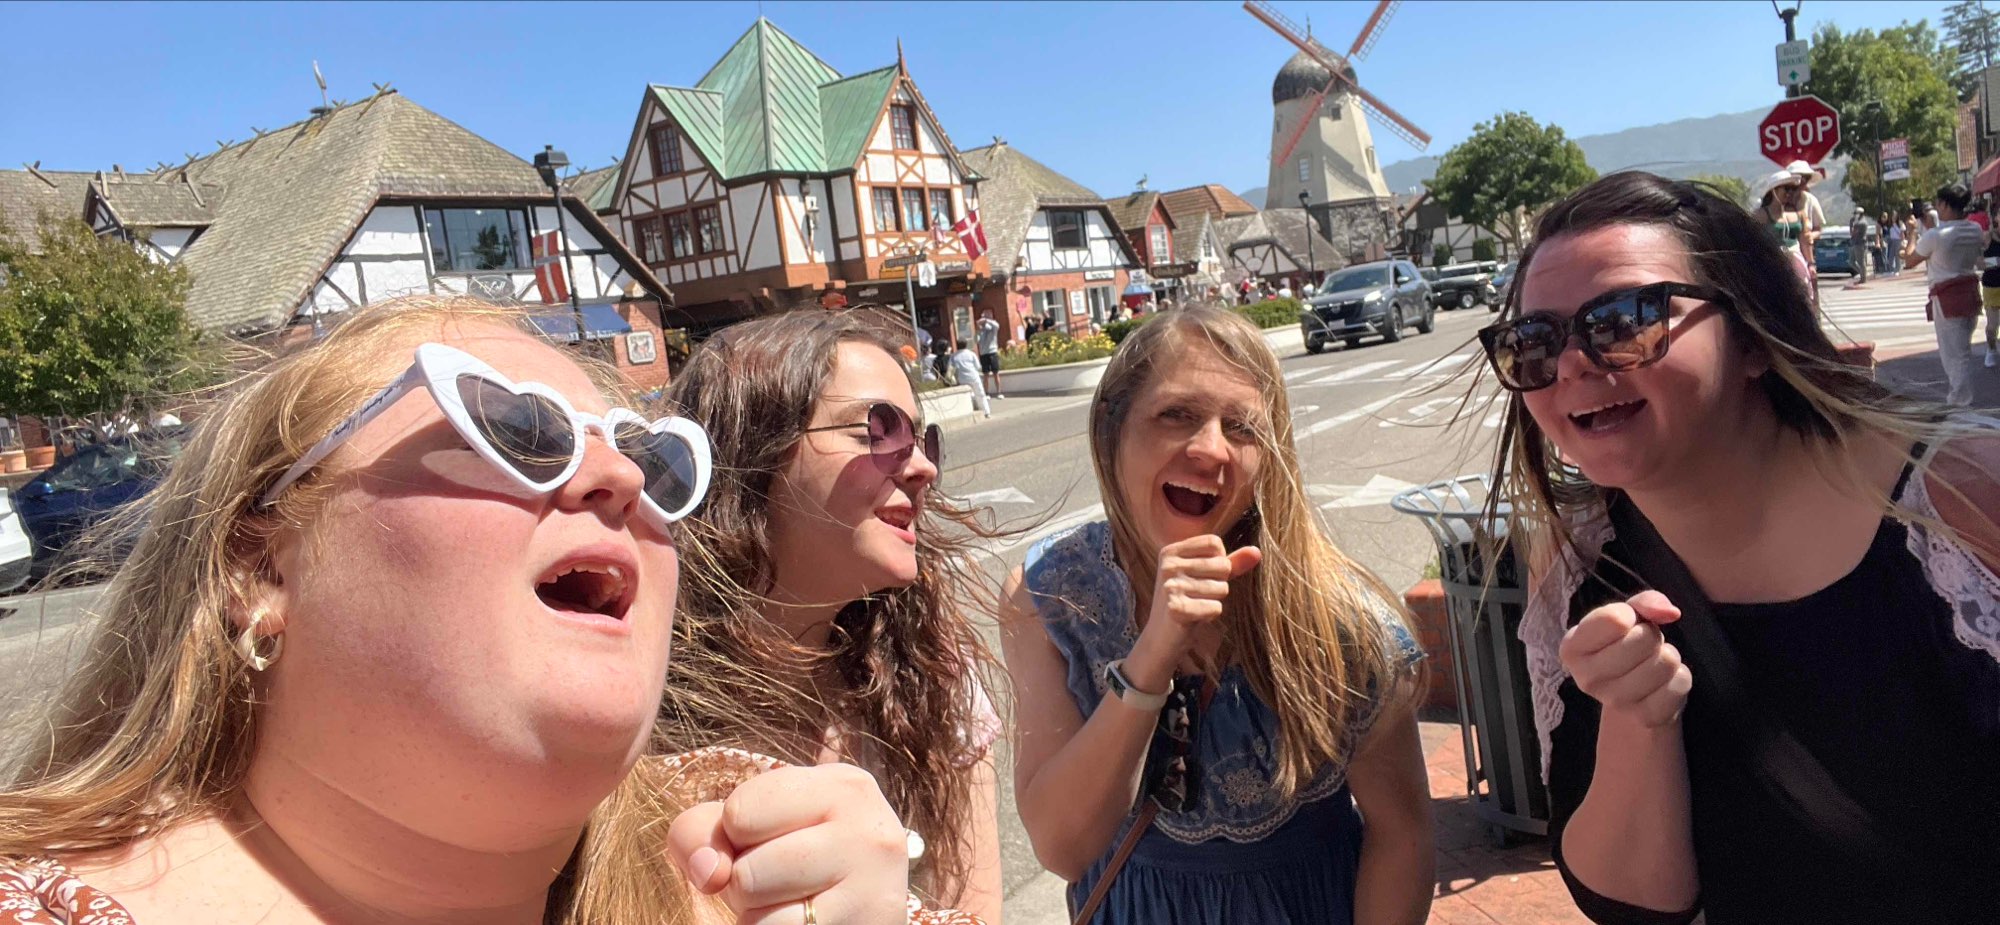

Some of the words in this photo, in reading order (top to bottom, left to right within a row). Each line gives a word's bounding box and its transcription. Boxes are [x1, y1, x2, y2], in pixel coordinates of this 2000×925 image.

[1783, 46, 1800, 56] BUS
[1778, 54, 1807, 66] PARKING
[1764, 115, 1833, 151] STOP
